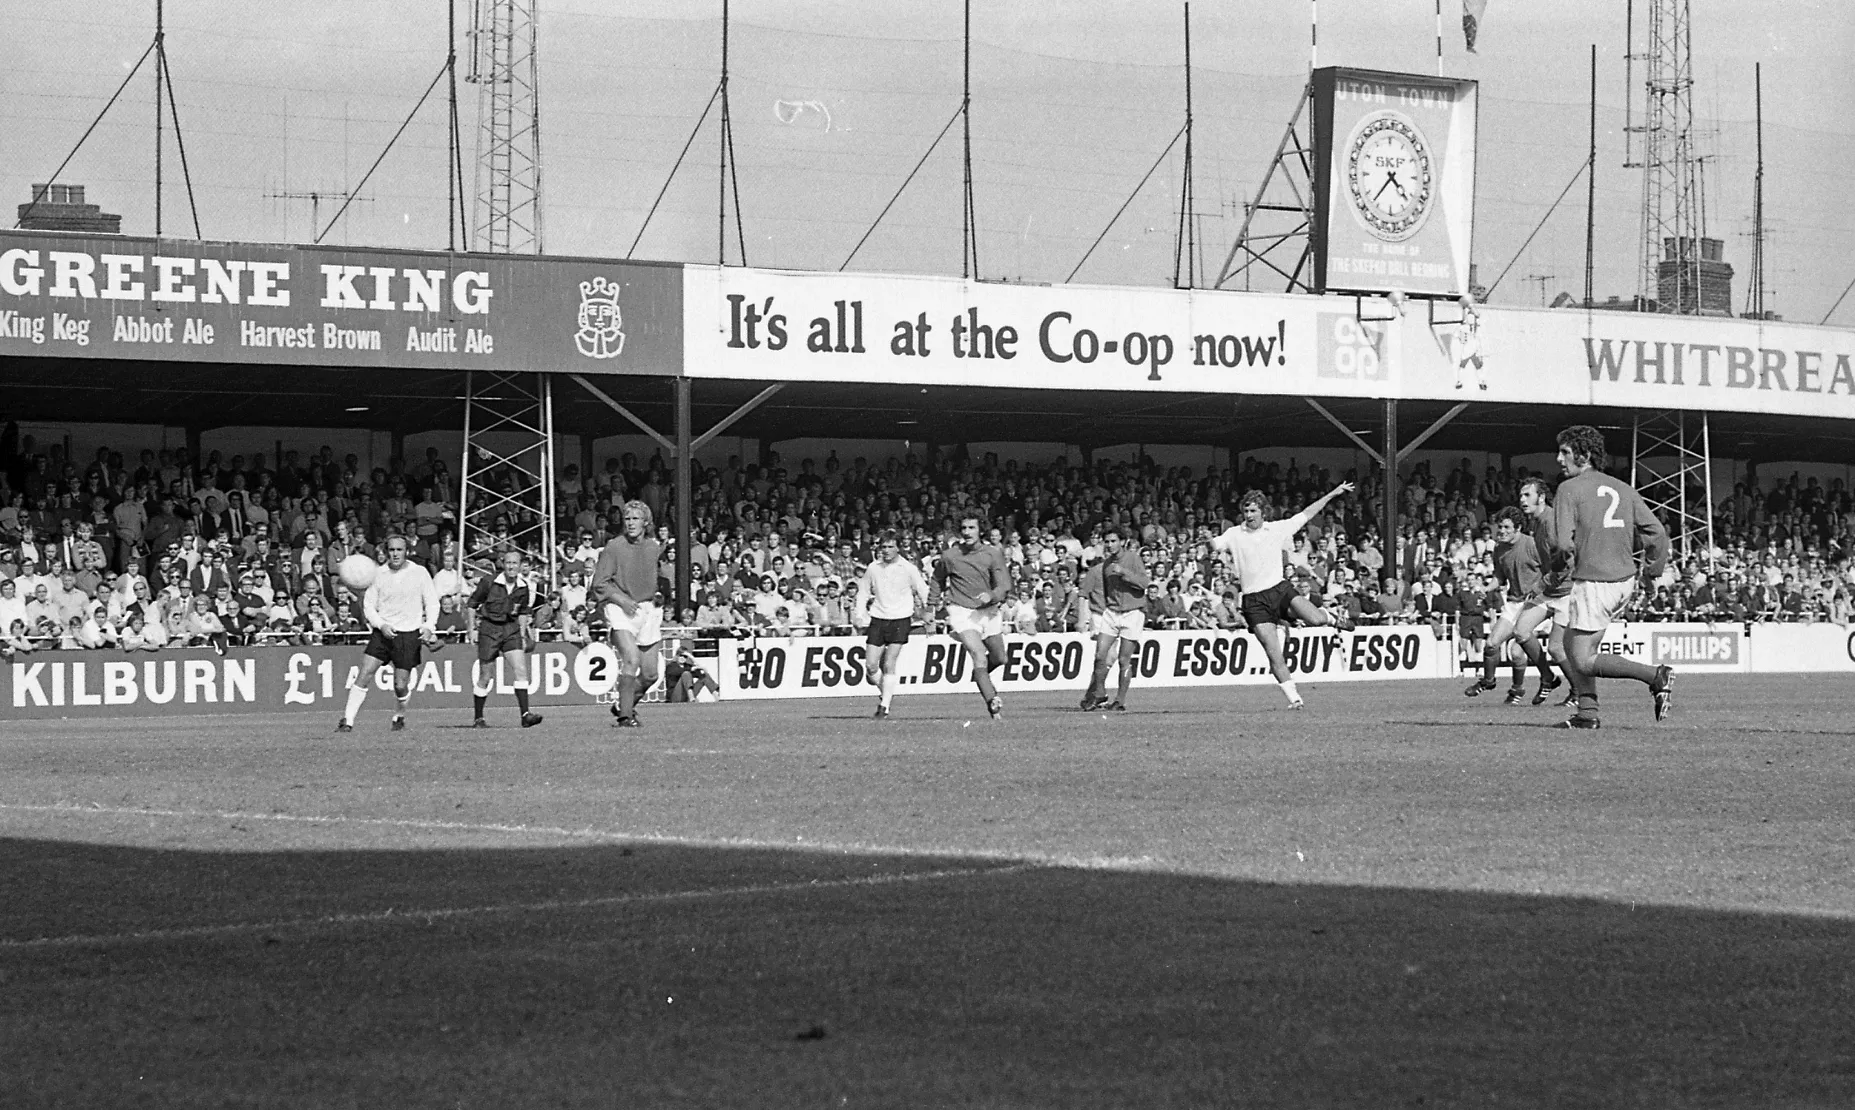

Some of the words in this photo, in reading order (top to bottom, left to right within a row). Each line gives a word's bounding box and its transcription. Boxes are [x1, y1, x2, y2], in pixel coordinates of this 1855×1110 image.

[1336, 81, 1386, 104] UTON
[1398, 87, 1449, 109] TOWN
[1375, 156, 1405, 168] SKF
[0, 248, 291, 307] GREENE
[320, 264, 494, 314] KING
[0, 310, 46, 344] King
[53, 312, 91, 347] Keg
[113, 315, 174, 344] Abbot
[182, 318, 215, 345] Ale
[240, 320, 316, 348] Harvest
[323, 323, 381, 350] Brown
[406, 326, 458, 353] Audit
[464, 329, 494, 354] Ale
[726, 294, 788, 351] It's
[807, 300, 866, 353] all
[890, 311, 932, 357] at
[950, 306, 1019, 360] the
[1039, 311, 1174, 381] Co-op
[1193, 319, 1286, 368] now!
[1582, 337, 1855, 396] WHITBREA
[1597, 485, 1625, 529] 2
[588, 656, 607, 681] 2
[922, 643, 977, 684] BU
[1002, 641, 1083, 682] ESSO
[1283, 636, 1335, 674] BUY
[1349, 633, 1421, 672] ESSO
[1600, 642, 1645, 655] RENT
[1657, 636, 1732, 660] PHILIPS
[12, 658, 256, 707] KILBURN
[284, 652, 333, 705] £1
